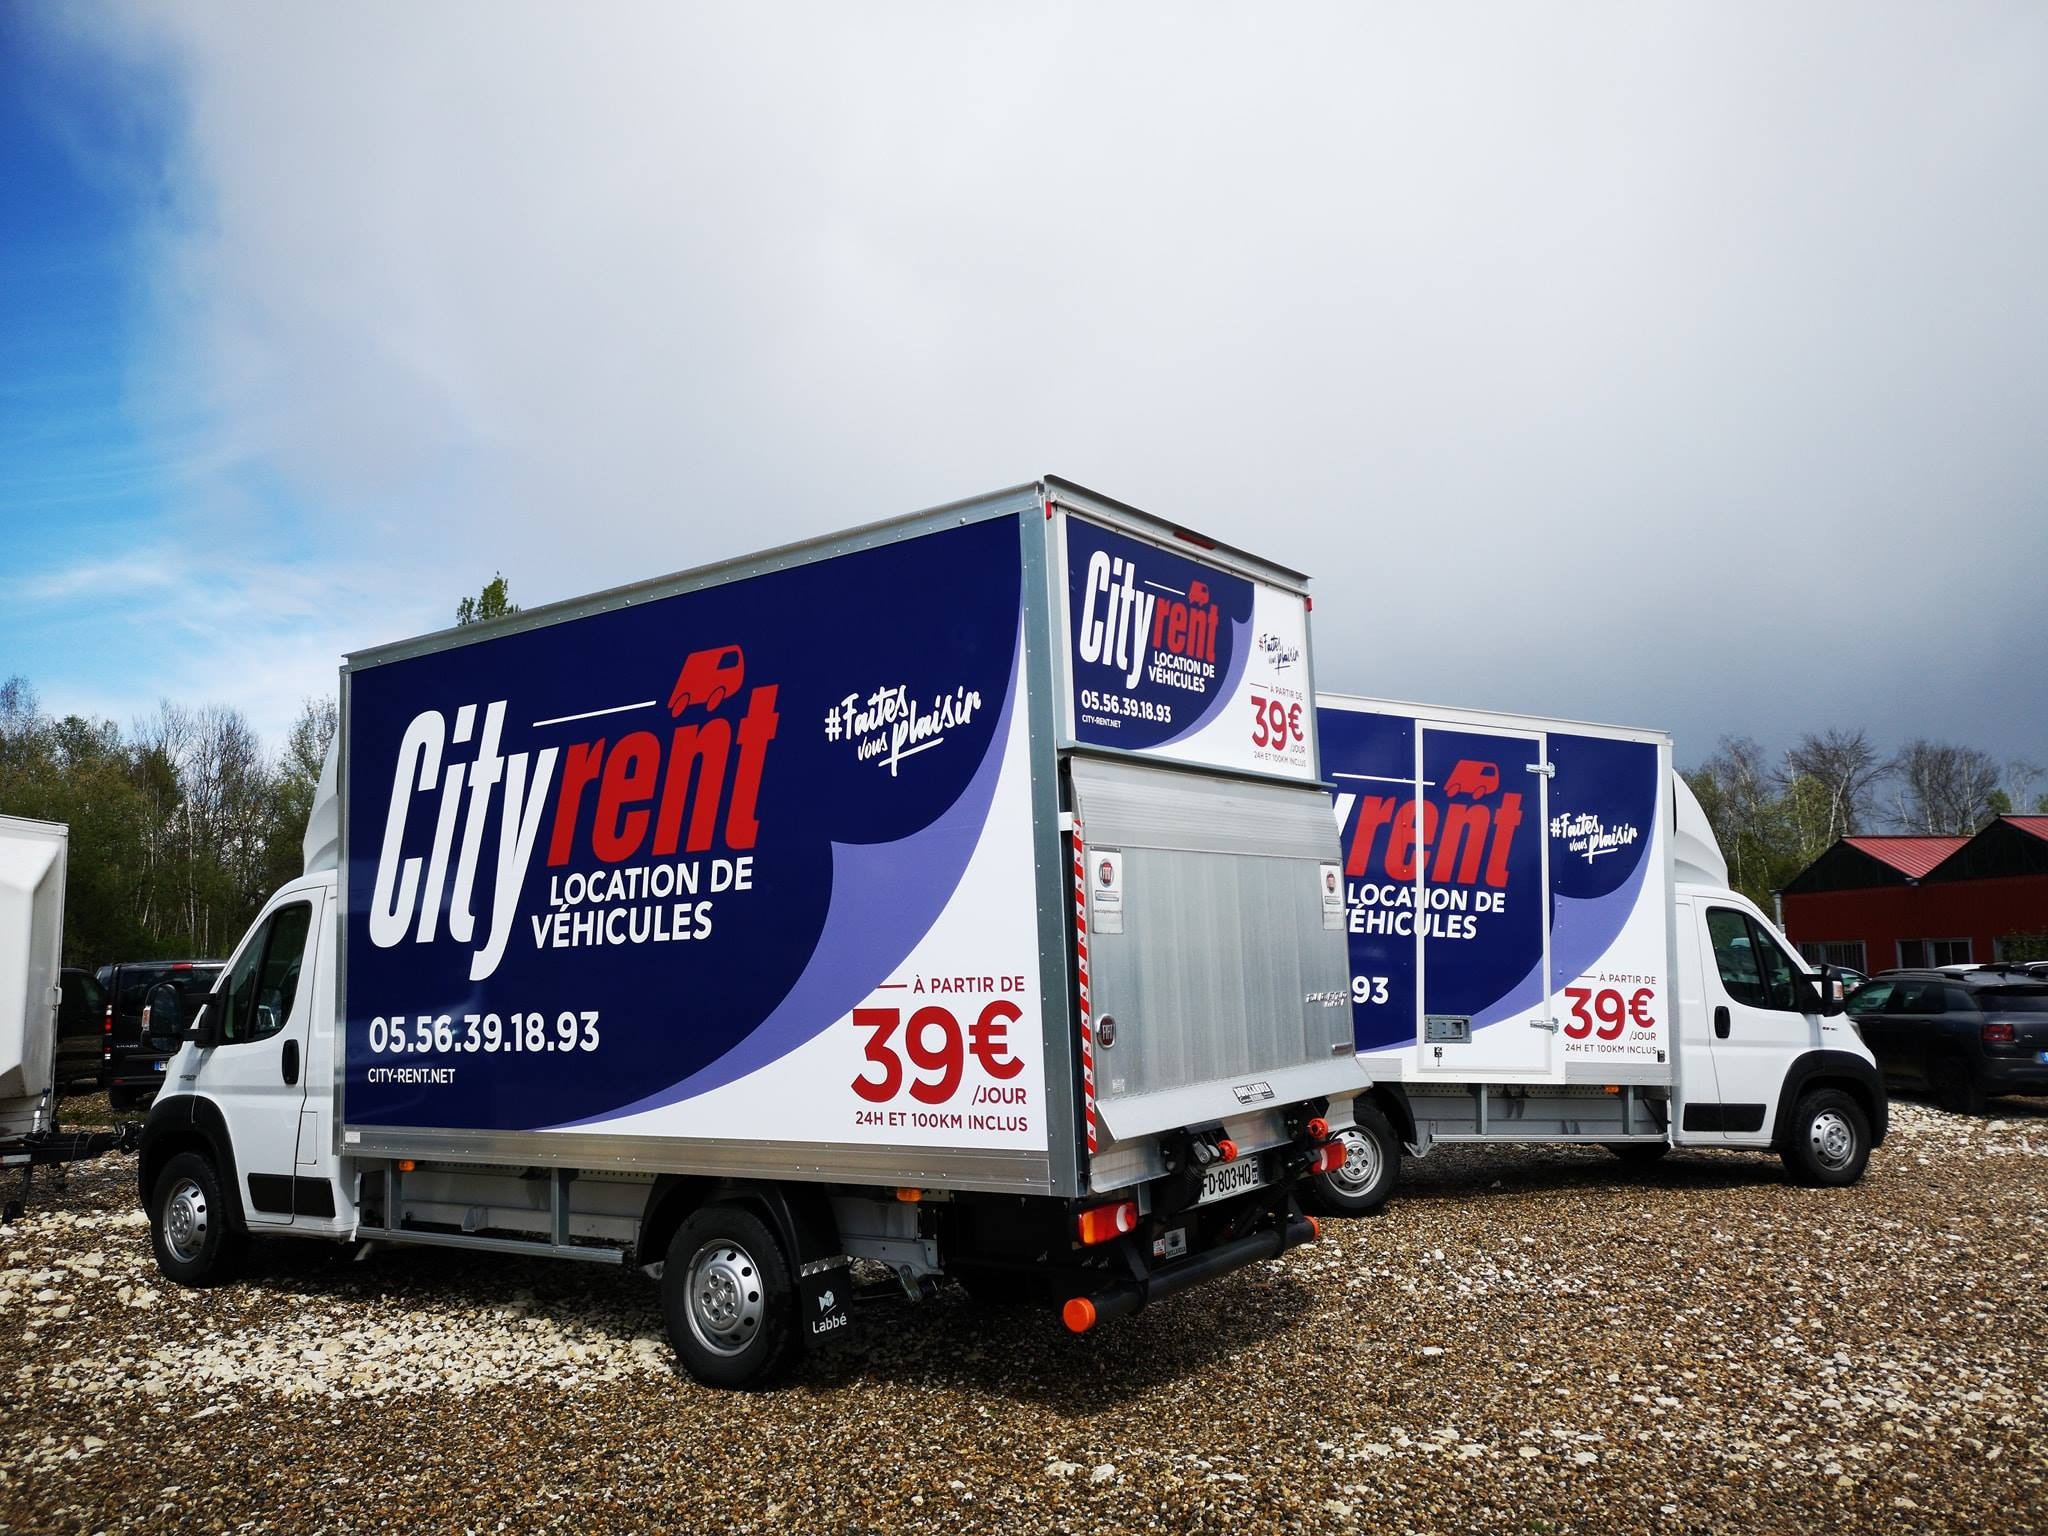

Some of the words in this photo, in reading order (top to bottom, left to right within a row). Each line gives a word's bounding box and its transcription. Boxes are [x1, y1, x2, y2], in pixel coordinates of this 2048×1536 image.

[1148, 662, 1206, 693] VÉHICULES
[1154, 650, 1201, 675] LOCATION
[1202, 662, 1215, 678] DE
[824, 684, 909, 742] #Faites
[1081, 689, 1172, 724] 05.56.39.18.93
[1081, 713, 1122, 729] CITY-RENT.NET
[889, 685, 982, 777] plaisir
[1251, 695, 1304, 751] 39€
[857, 731, 888, 761] vous
[1333, 791, 1523, 888] rent
[1550, 812, 1600, 838] #Faites
[1588, 823, 1638, 865] plaisir
[550, 860, 700, 906] LOCATION
[710, 856, 753, 893] DE
[1475, 891, 1506, 914] DE
[531, 900, 713, 949] VÉHICULES
[1346, 904, 1478, 940] ÉHICULES
[913, 974, 925, 994] À
[931, 976, 994, 993] PARTIR
[1001, 975, 1025, 992] DE
[1600, 970, 1606, 982] À
[1608, 973, 1642, 985] PARTIR
[1644, 975, 1656, 985] DE
[1563, 987, 1655, 1040] 39€
[368, 1010, 600, 1053] 05.56.39.18.93
[1629, 1030, 1656, 1041] /JOUR
[851, 999, 1026, 1105] 39€
[1565, 1043, 1581, 1052] 24H
[1584, 1044, 1595, 1052] ET
[1597, 1044, 1625, 1053] 100KM
[1626, 1045, 1657, 1055] INCLUS
[367, 1067, 456, 1084] CITY-RENT.NET
[971, 1085, 1027, 1106] /JOUR
[855, 1110, 884, 1125] 24H
[888, 1112, 907, 1127] ET
[911, 1112, 962, 1129] 100KM
[968, 1114, 1028, 1132] INCLUS
[812, 1312, 848, 1335] Labbé
